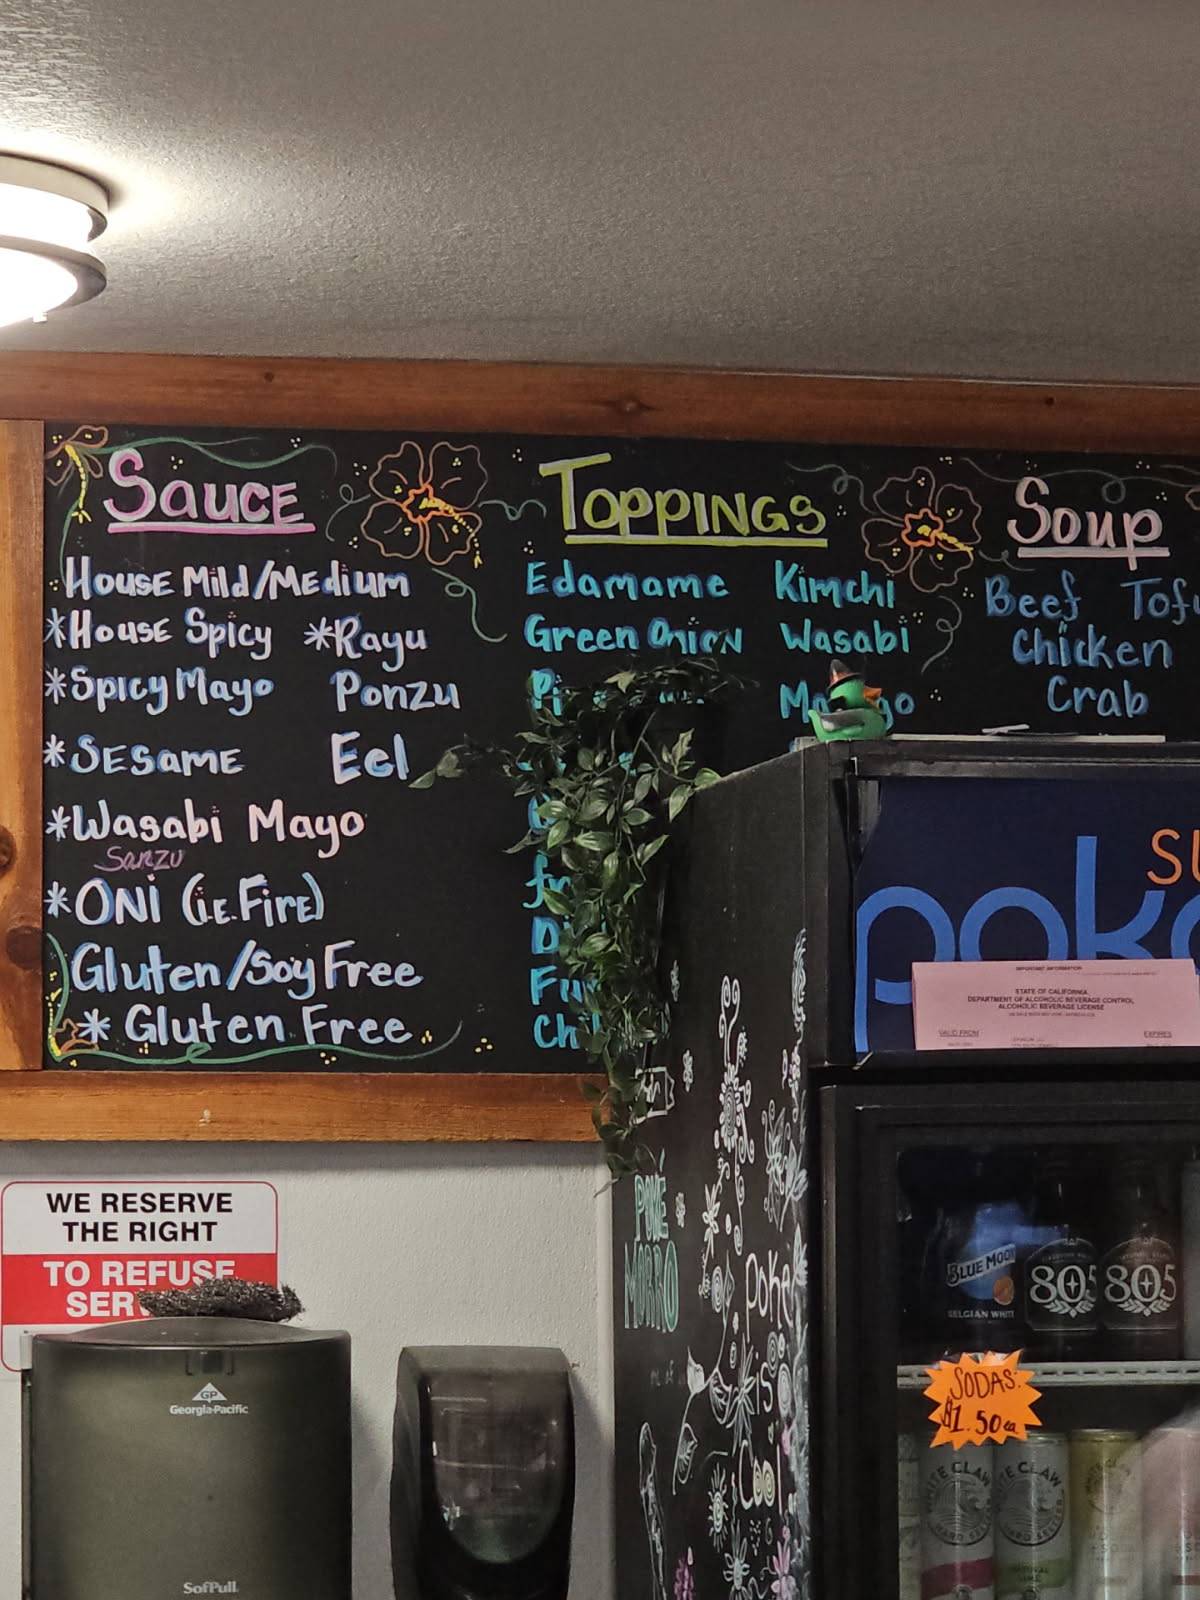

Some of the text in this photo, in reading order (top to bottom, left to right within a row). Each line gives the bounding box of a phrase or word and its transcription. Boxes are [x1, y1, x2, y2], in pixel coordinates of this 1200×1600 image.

[1007, 477, 1163, 571] Soup
[526, 559, 729, 599] Edamame
[774, 559, 895, 609] Kimchi
[985, 569, 1081, 622] Beef
[184, 607, 272, 659] Spicy
[524, 613, 639, 653] Green
[779, 618, 910, 654] Wasabi
[1012, 621, 1173, 669] Chicken
[176, 668, 274, 716] Mayo
[330, 670, 461, 712] Ponzu
[779, 680, 916, 731] Mago
[1047, 675, 1149, 718] Crab
[330, 731, 410, 785] Eel
[249, 799, 365, 859] Mayo
[324, 939, 423, 989] Free
[124, 1003, 285, 1045] Gluten
[302, 1004, 413, 1045] Free
[47, 1192, 233, 1213] WE RESERVE
[62, 1221, 218, 1242] THE RIGHT
[43, 1260, 235, 1287] TO REFUSE
[946, 1258, 983, 1288] BLUE
[1104, 1264, 1177, 1304] 805
[200, 1390, 218, 1400] GP
